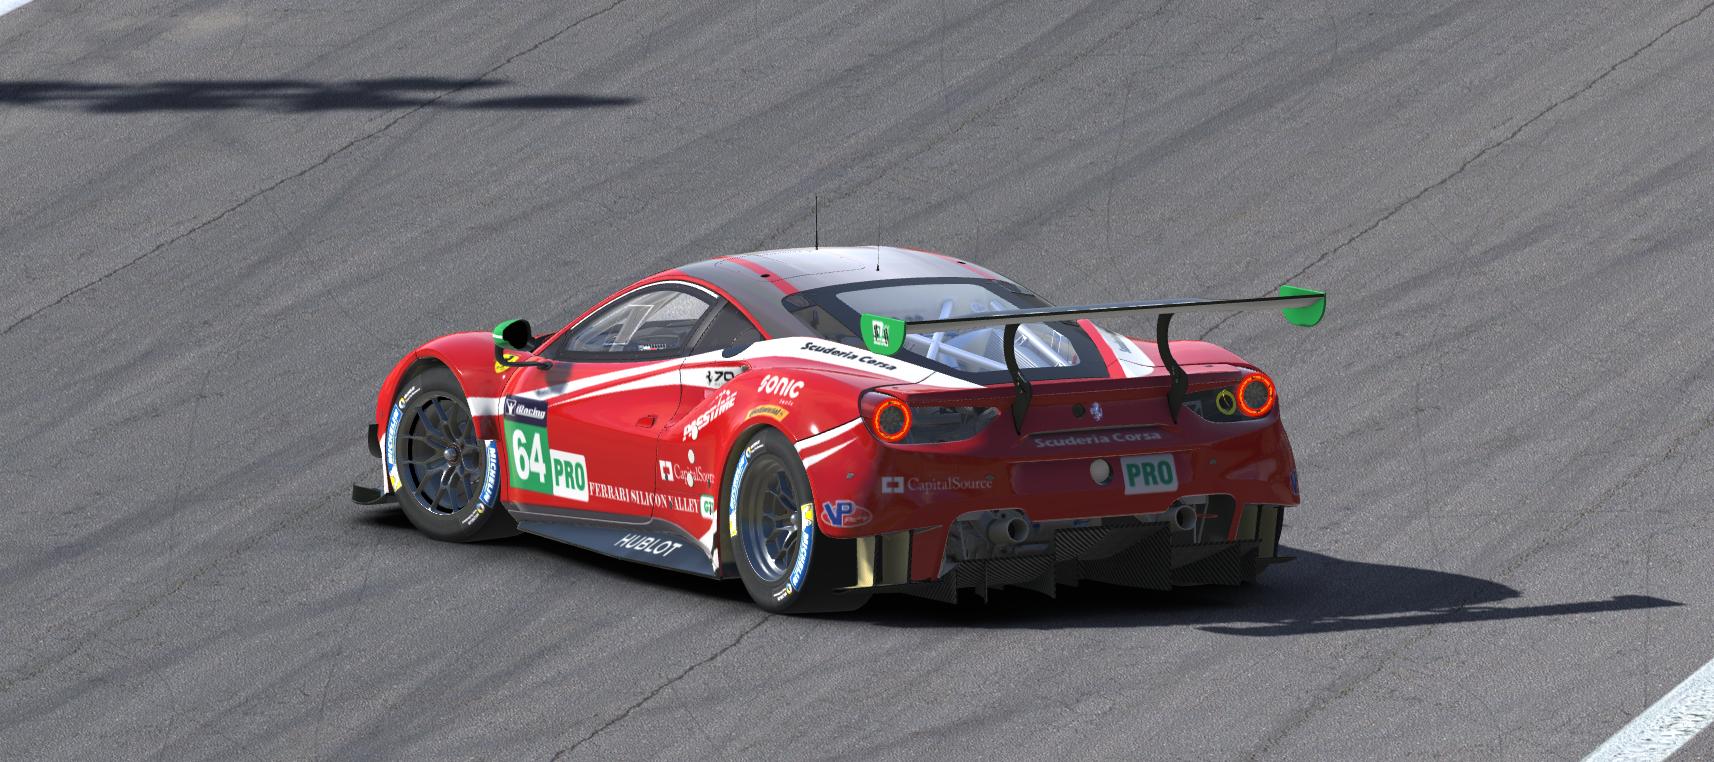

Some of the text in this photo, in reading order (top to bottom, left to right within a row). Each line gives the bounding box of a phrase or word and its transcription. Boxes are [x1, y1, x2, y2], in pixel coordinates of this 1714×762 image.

[801, 341, 897, 371] Scuderia Corsa
[516, 404, 546, 419] iRacing
[1034, 431, 1162, 448] Scuderia Corsa
[512, 428, 547, 483] 64
[482, 447, 497, 502] MICHELIN
[553, 458, 586, 491] PRO
[907, 476, 993, 494] CapitalSource
[1126, 460, 1174, 487] PRO
[589, 481, 699, 514] FERRARI SILICON VALLEY
[823, 500, 856, 528] VP
[613, 533, 683, 557] HUBLOT
